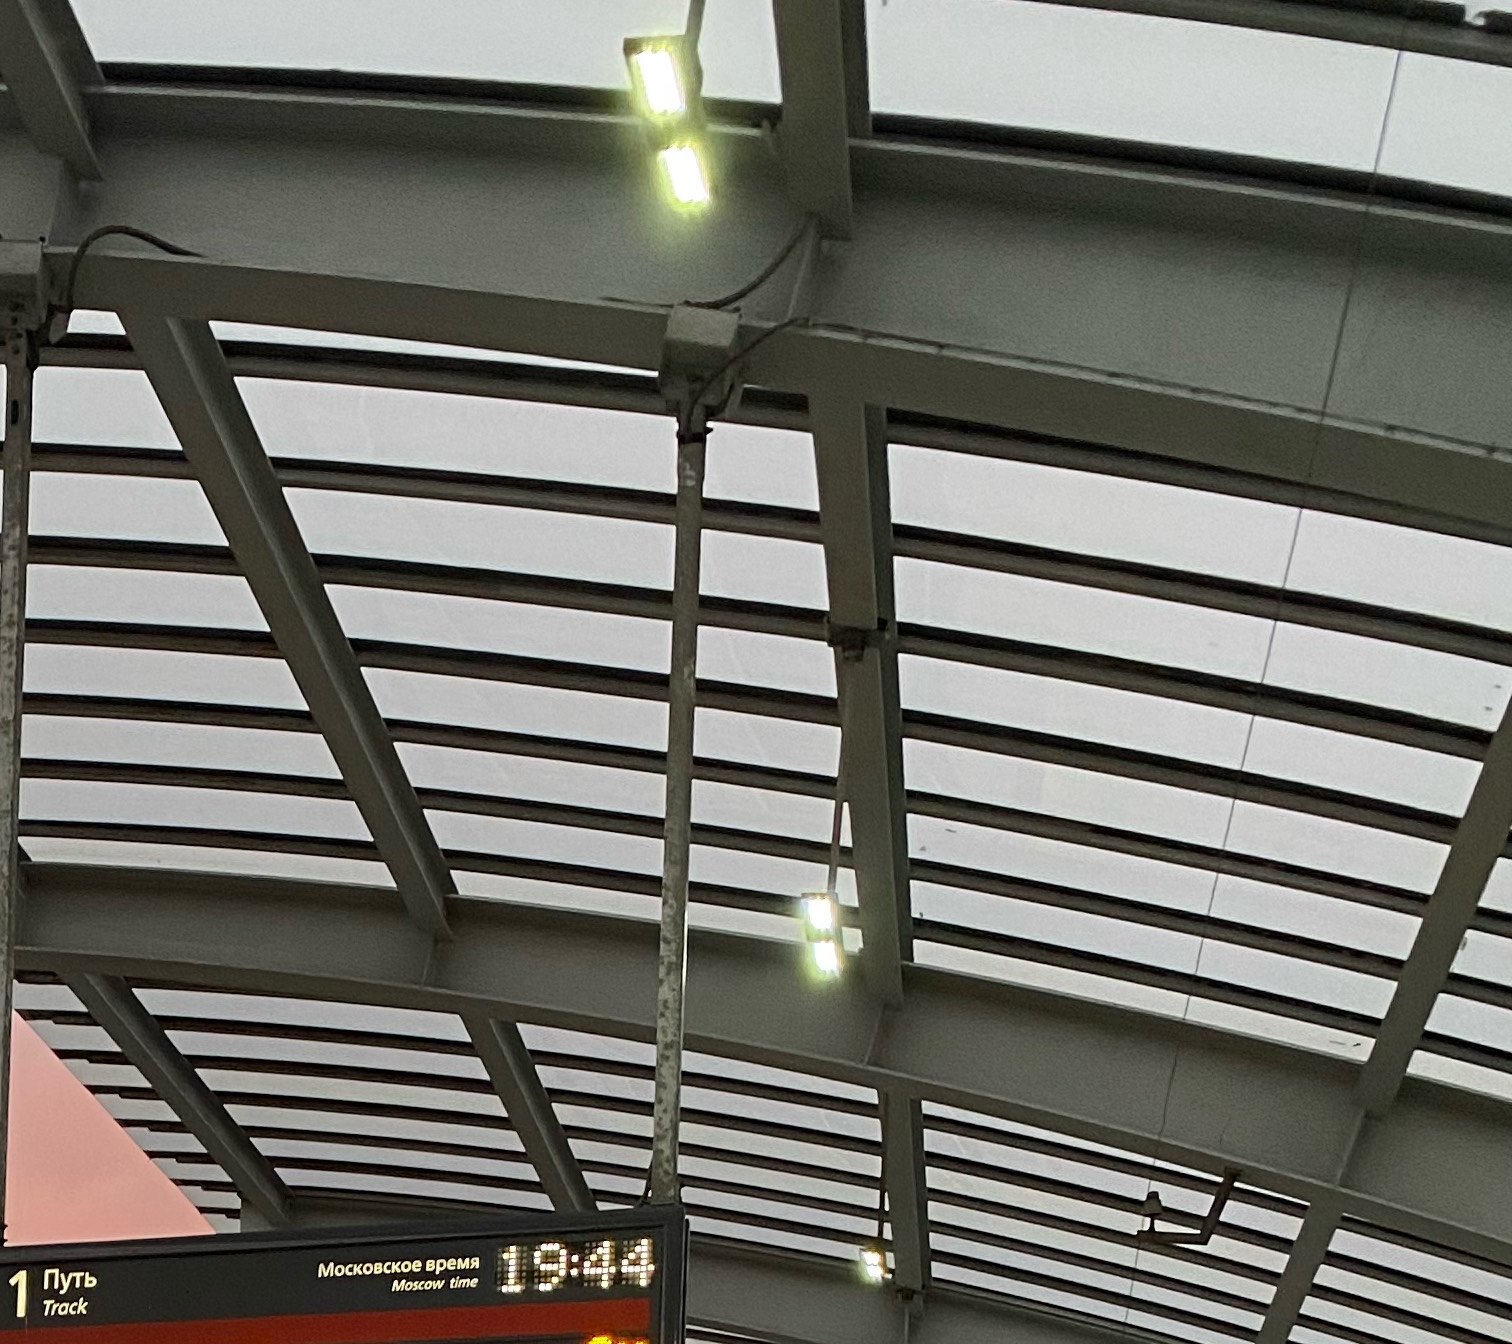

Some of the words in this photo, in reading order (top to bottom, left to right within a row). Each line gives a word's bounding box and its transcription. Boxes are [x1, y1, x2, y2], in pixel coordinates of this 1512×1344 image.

[317, 1259, 422, 1279] Московское
[425, 1256, 481, 1276] время
[497, 1238, 655, 1293] 19:44
[8, 1269, 28, 1318] 1
[43, 1267, 98, 1295] Путь
[391, 1277, 446, 1293] Moscow
[449, 1275, 479, 1290] time
[43, 1297, 88, 1317] Track
